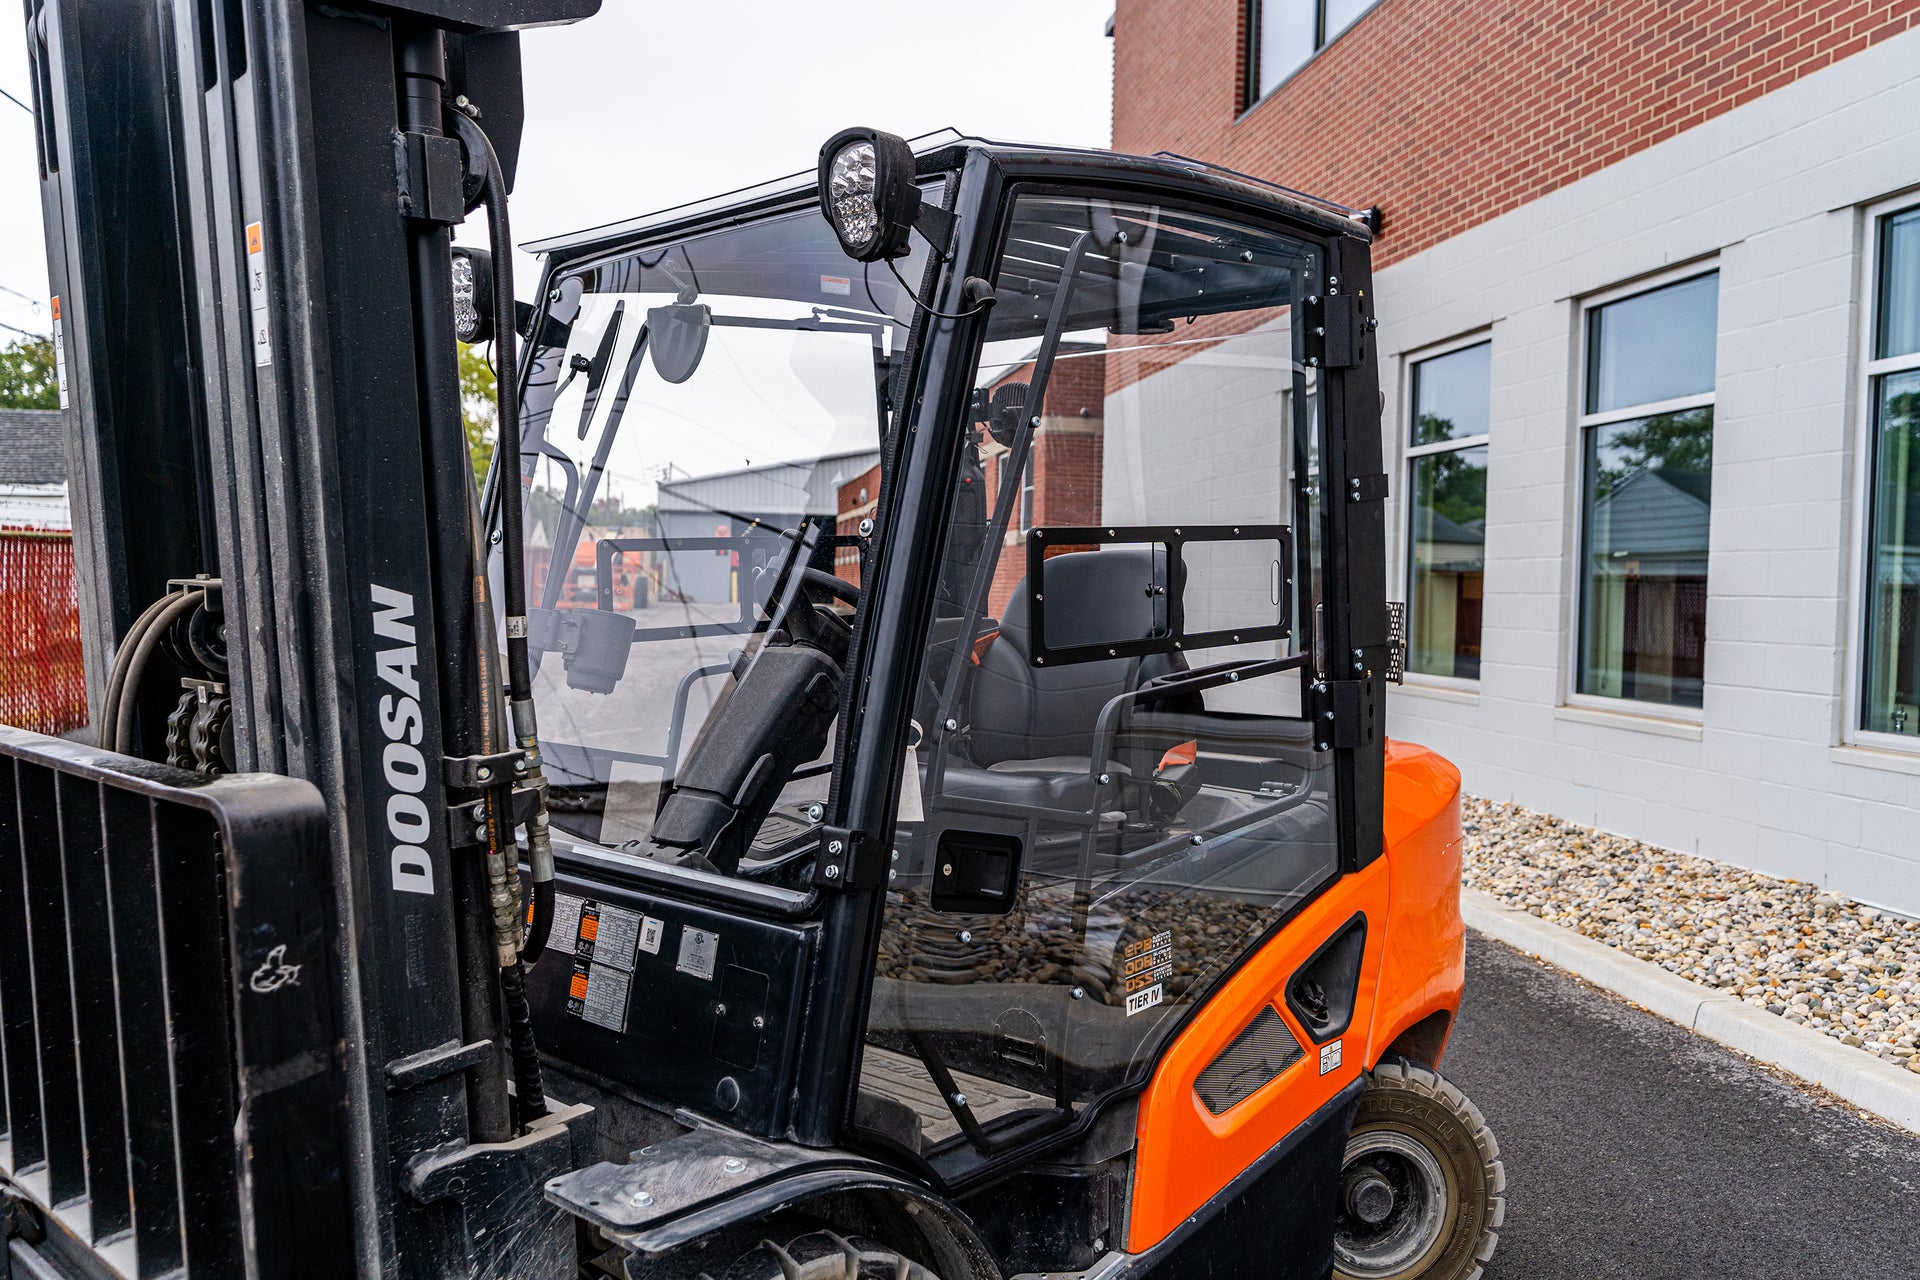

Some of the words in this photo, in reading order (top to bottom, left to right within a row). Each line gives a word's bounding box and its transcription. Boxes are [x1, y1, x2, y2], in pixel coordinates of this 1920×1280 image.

[371, 583, 434, 895] DOOSAN
[1124, 937, 1153, 958] EPB
[1125, 954, 1153, 975] ODB
[1126, 971, 1154, 992] OSS
[1129, 993, 1149, 1011] TIER
[1151, 988, 1160, 1002] IV
[1368, 1098, 1456, 1141] NEXEN
